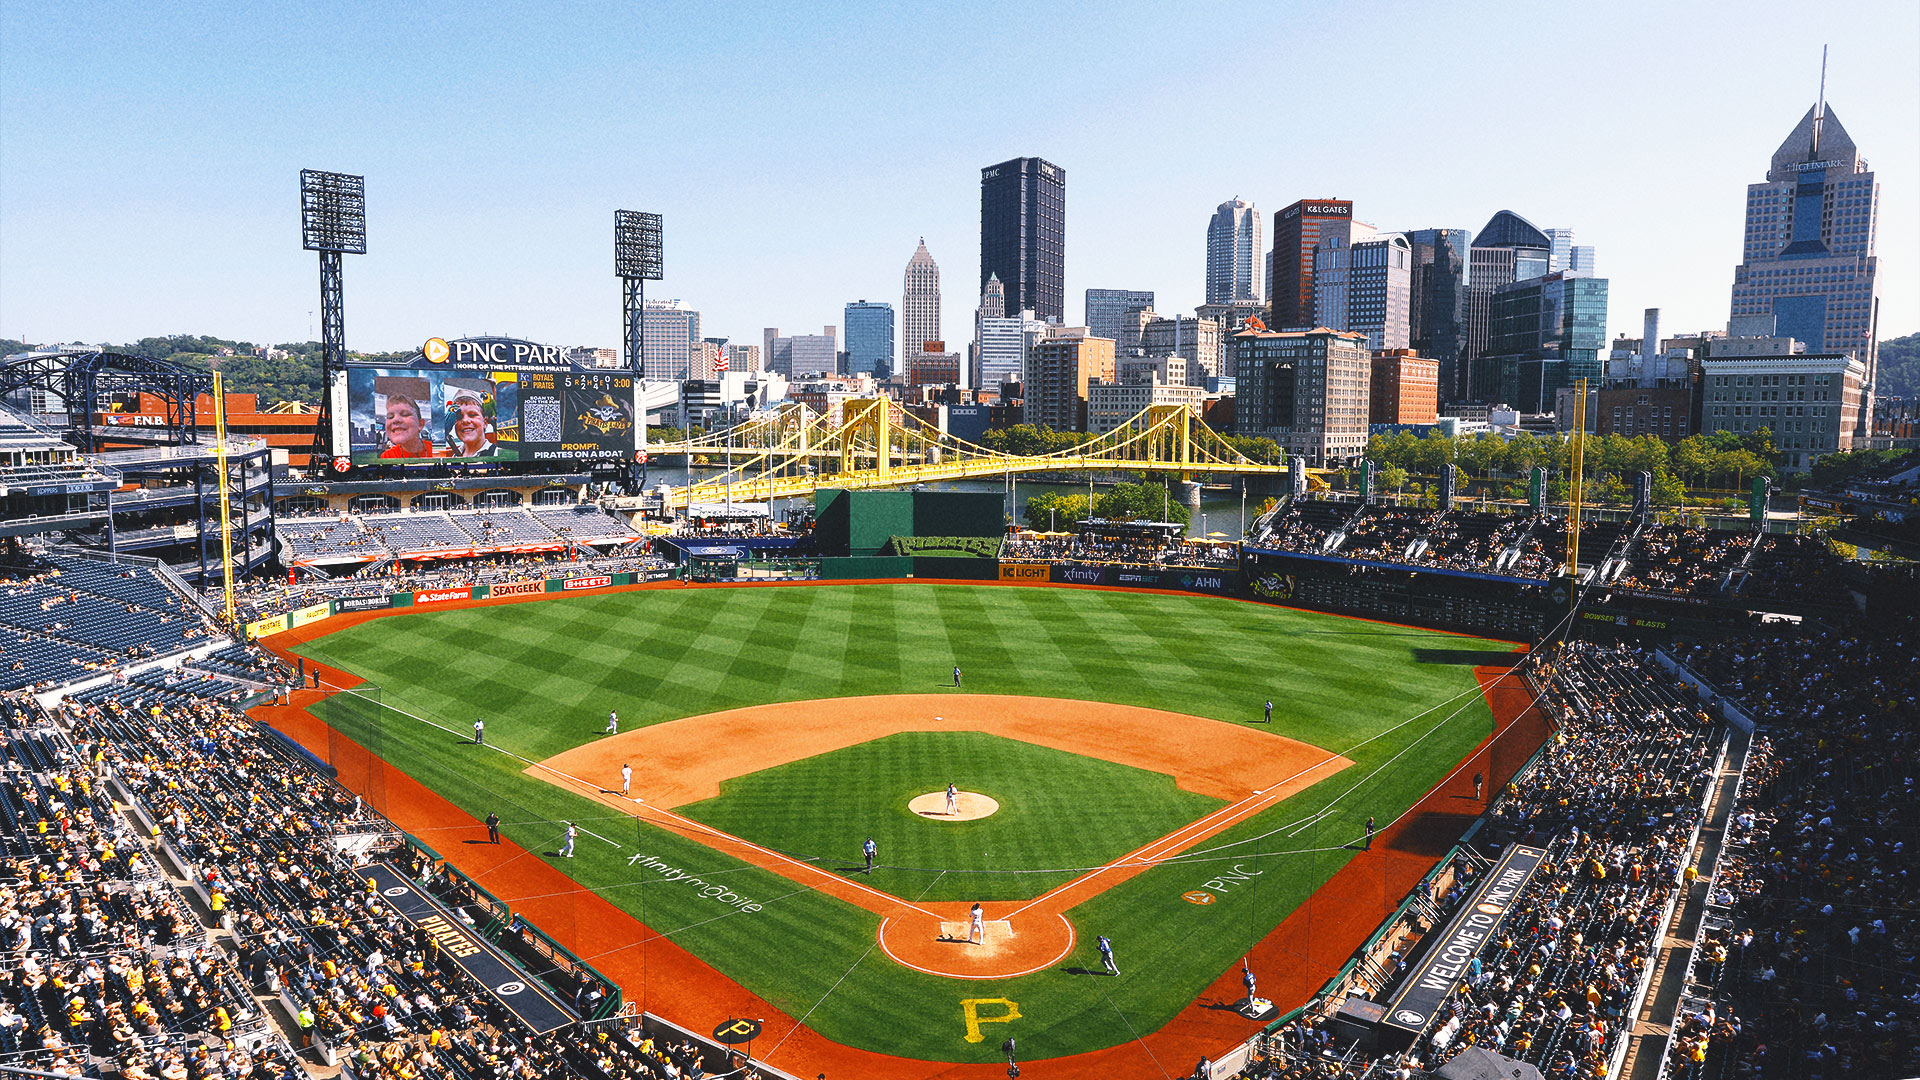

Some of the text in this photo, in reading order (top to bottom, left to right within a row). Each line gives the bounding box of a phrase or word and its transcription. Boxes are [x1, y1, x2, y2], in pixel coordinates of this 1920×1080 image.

[1041, 163, 1056, 177] UPMC
[1307, 205, 1348, 214] K&L GATES
[453, 341, 572, 365] PNC PARK
[564, 377, 572, 387] 5
[614, 378, 631, 388] 3:00
[134, 415, 166, 426] F.N.B.
[534, 451, 573, 459] PIRATES
[598, 450, 624, 458] BOAT
[1016, 568, 1046, 577] LIGHT
[1063, 567, 1100, 582] xfinity
[493, 582, 541, 596] SEATGEEK
[567, 577, 609, 588] SHEETZ
[1195, 576, 1221, 588] AHN
[1646, 593, 1671, 601] delicious
[1583, 612, 1614, 622] BOWSER
[1636, 619, 1666, 629] BLASTS
[1517, 849, 1540, 858] P
[627, 853, 763, 914] xfinity mobile
[1201, 864, 1263, 893] PNC
[1420, 867, 1527, 990] WELCOME TO PNC PARK
[416, 914, 481, 958] PIRATES
[715, 1018, 756, 1037] P
[959, 997, 1023, 1044] P
